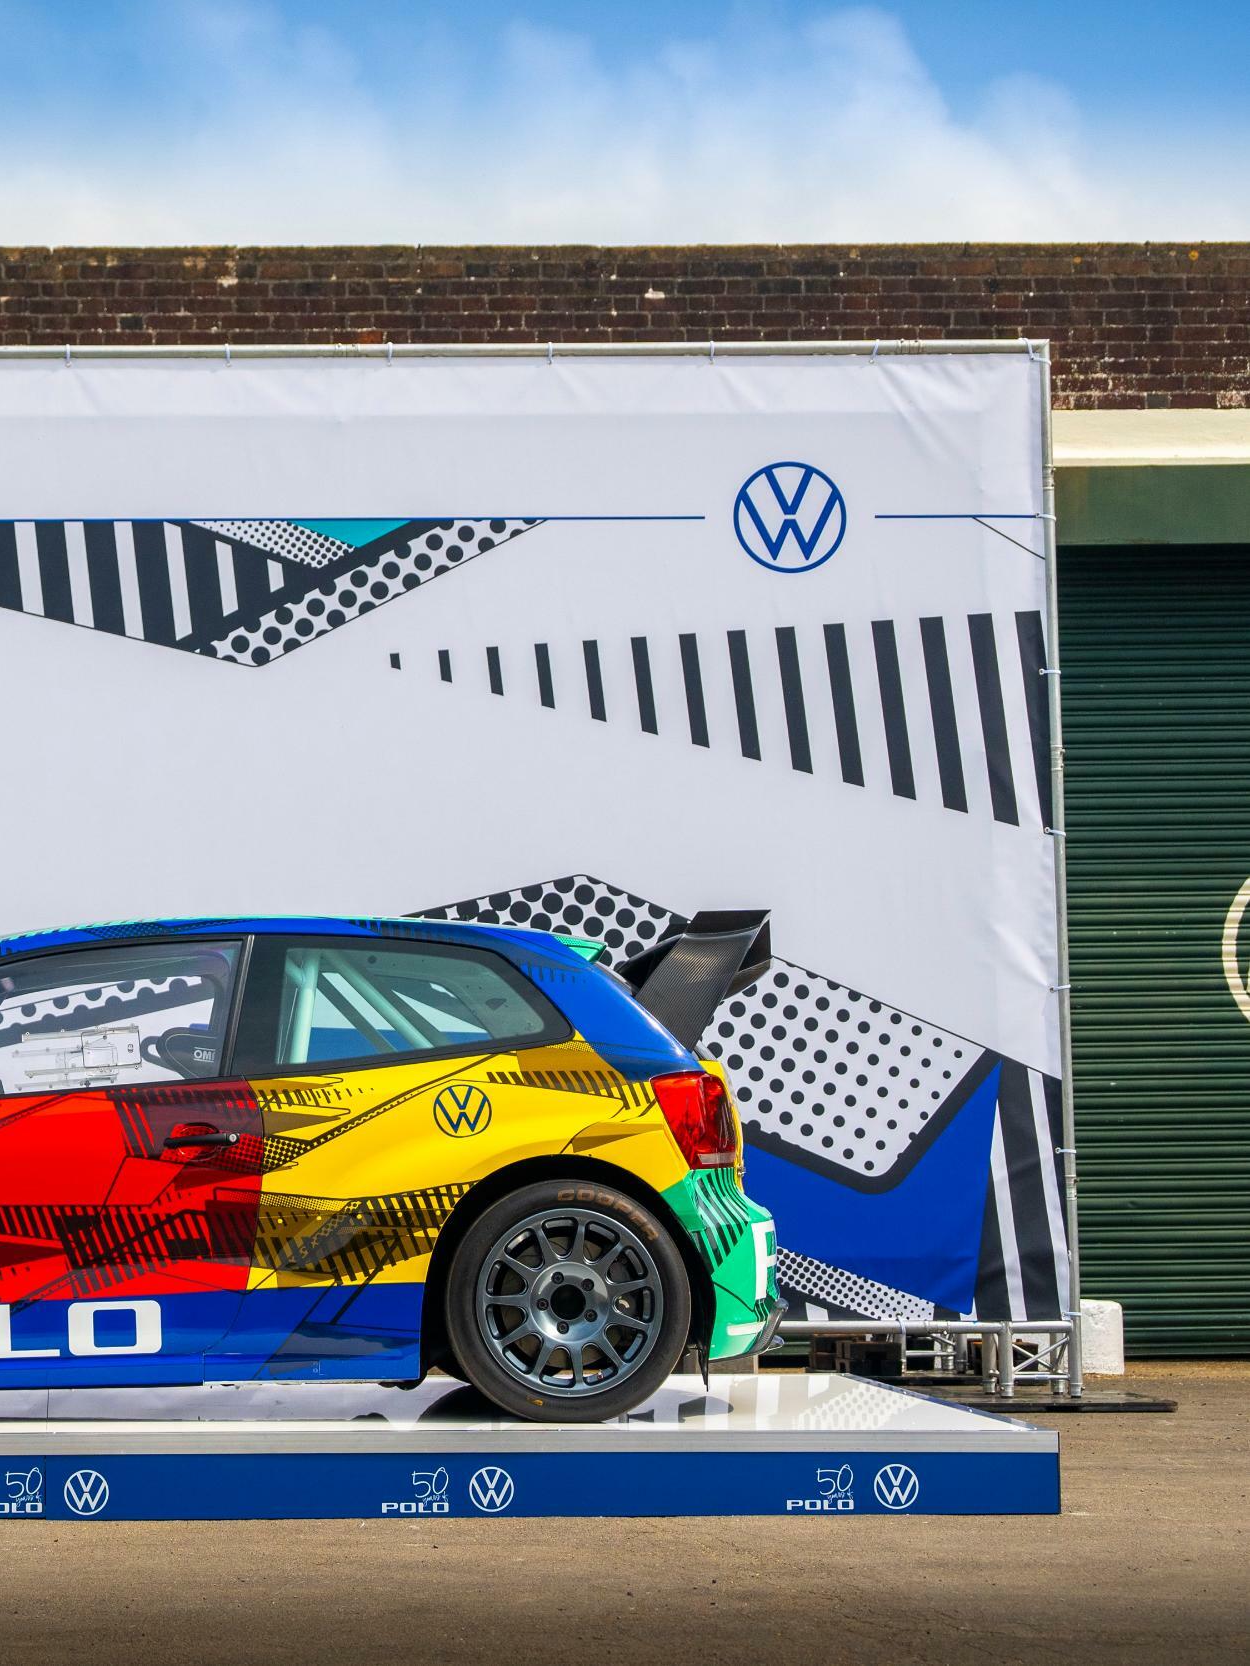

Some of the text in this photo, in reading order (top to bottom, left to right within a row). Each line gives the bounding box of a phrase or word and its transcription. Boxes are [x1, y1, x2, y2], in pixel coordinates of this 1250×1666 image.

[5, 1467, 43, 1498] 50
[411, 1467, 449, 1498] 50
[816, 1464, 854, 1495] 50
[381, 1502, 449, 1514] POLO
[786, 1499, 854, 1511] POLO
